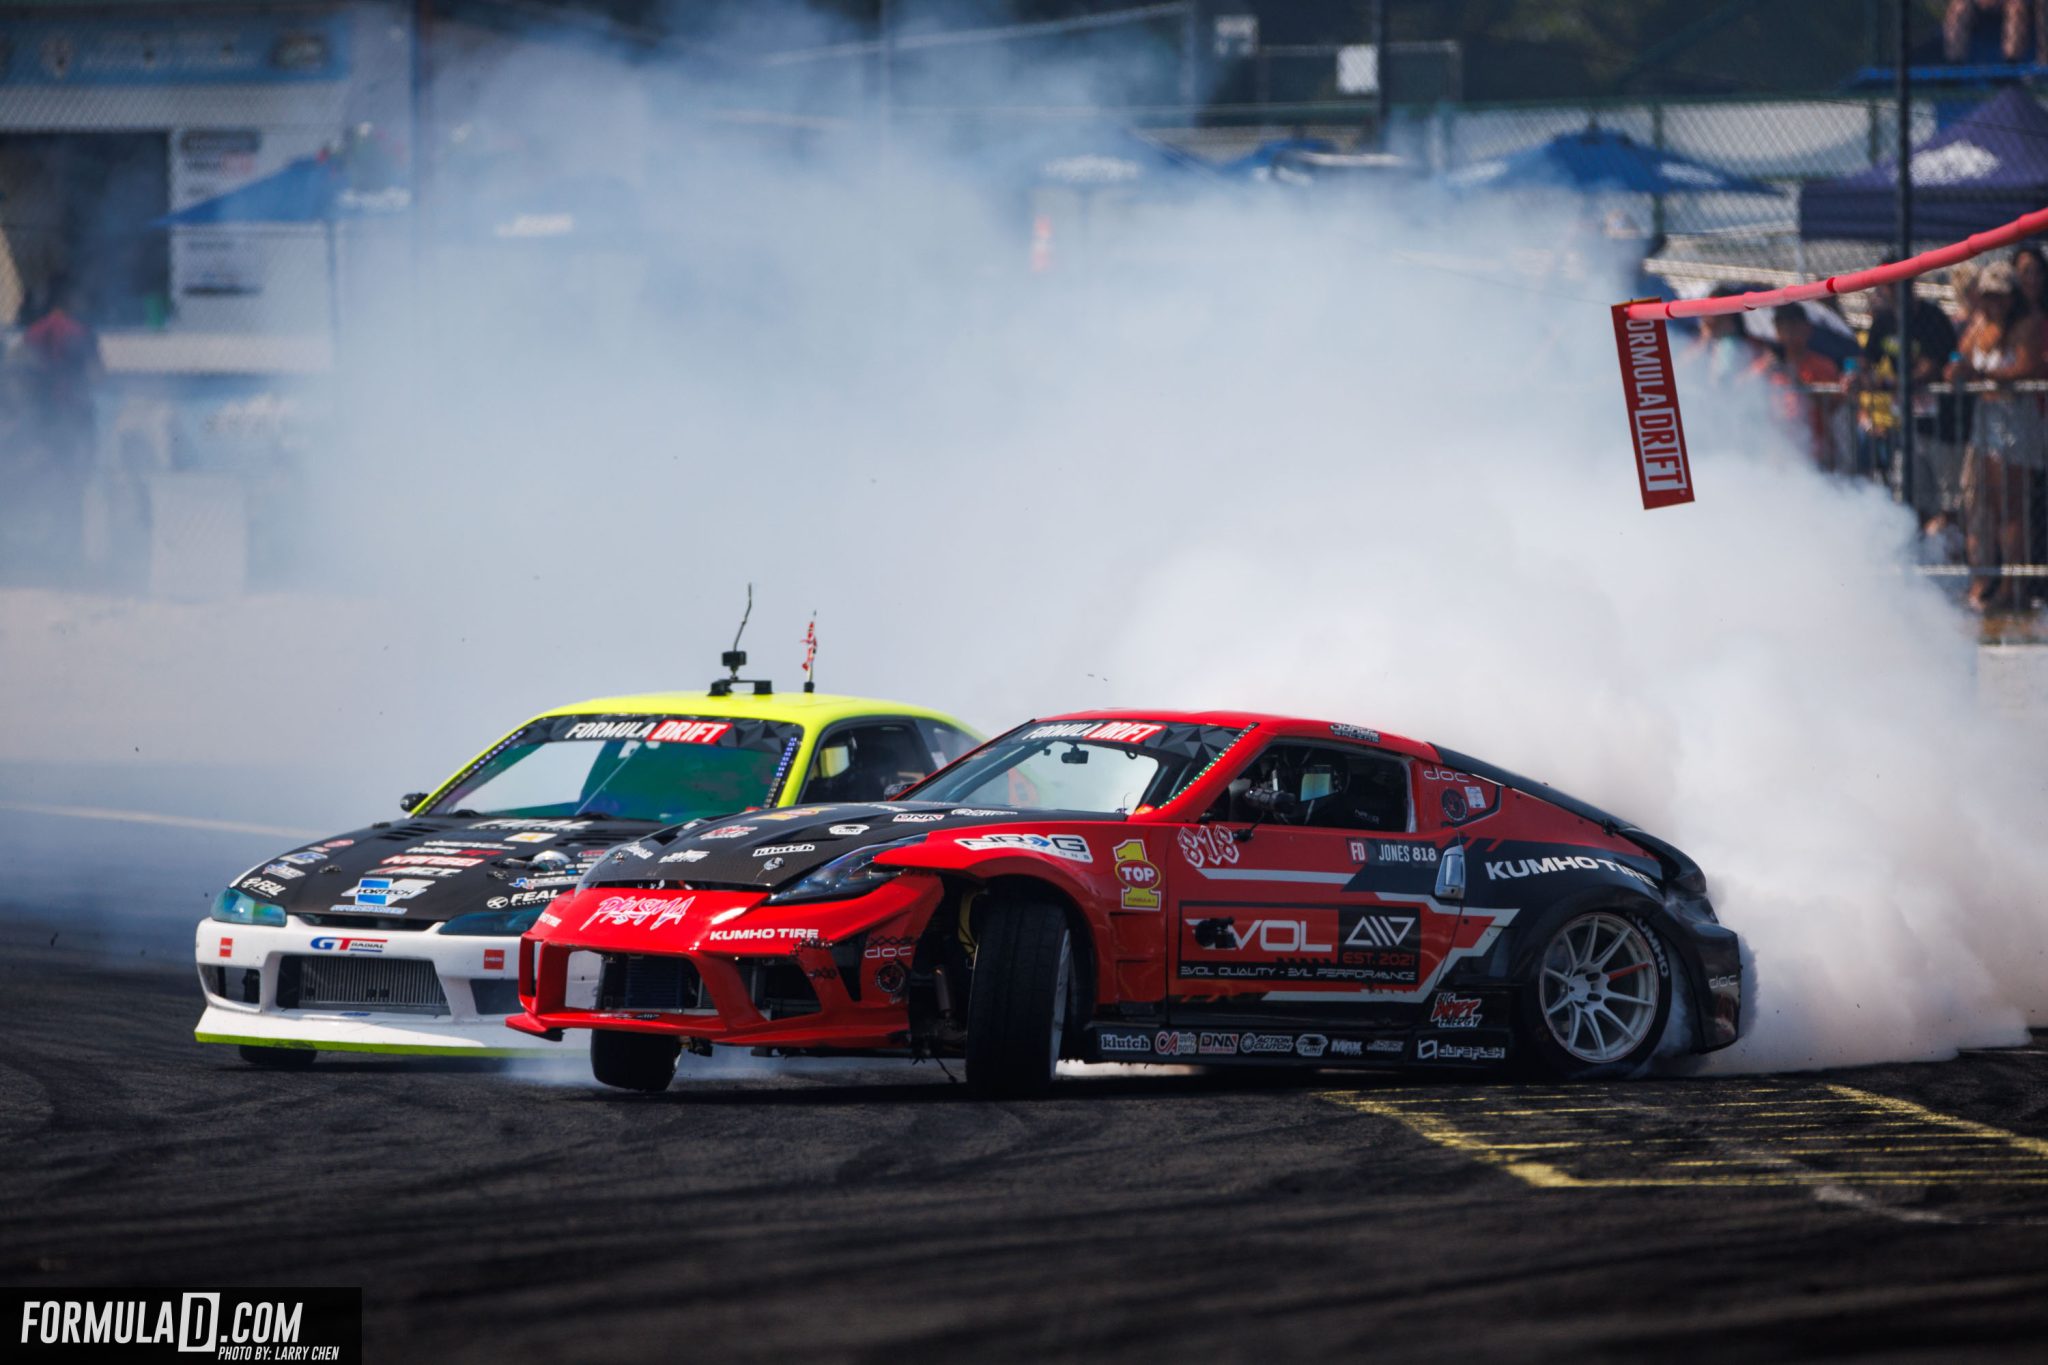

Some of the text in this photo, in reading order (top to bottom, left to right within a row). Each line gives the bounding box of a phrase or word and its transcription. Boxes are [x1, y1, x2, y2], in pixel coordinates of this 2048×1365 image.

[565, 720, 728, 743] FORMULA DRIFT
[1022, 721, 1164, 742] FORMULA DRIFT
[1177, 824, 1240, 868] 818
[1350, 842, 1366, 861] FD
[1379, 844, 1437, 862] JONES 818
[1121, 866, 1154, 882] TOP
[1485, 856, 1658, 889] KUMHO TIRE
[254, 879, 287, 897] FEAL
[356, 886, 415, 897] VORTECH
[511, 889, 560, 904] FEAL
[710, 928, 819, 941] KUMHO TIRE
[310, 936, 351, 951] GT
[1343, 952, 1376, 965] EST.
[1218, 967, 1276, 977] QUALITY
[1316, 969, 1417, 981] PERFORMANCE
[1201, 1034, 1237, 1047] DNA
